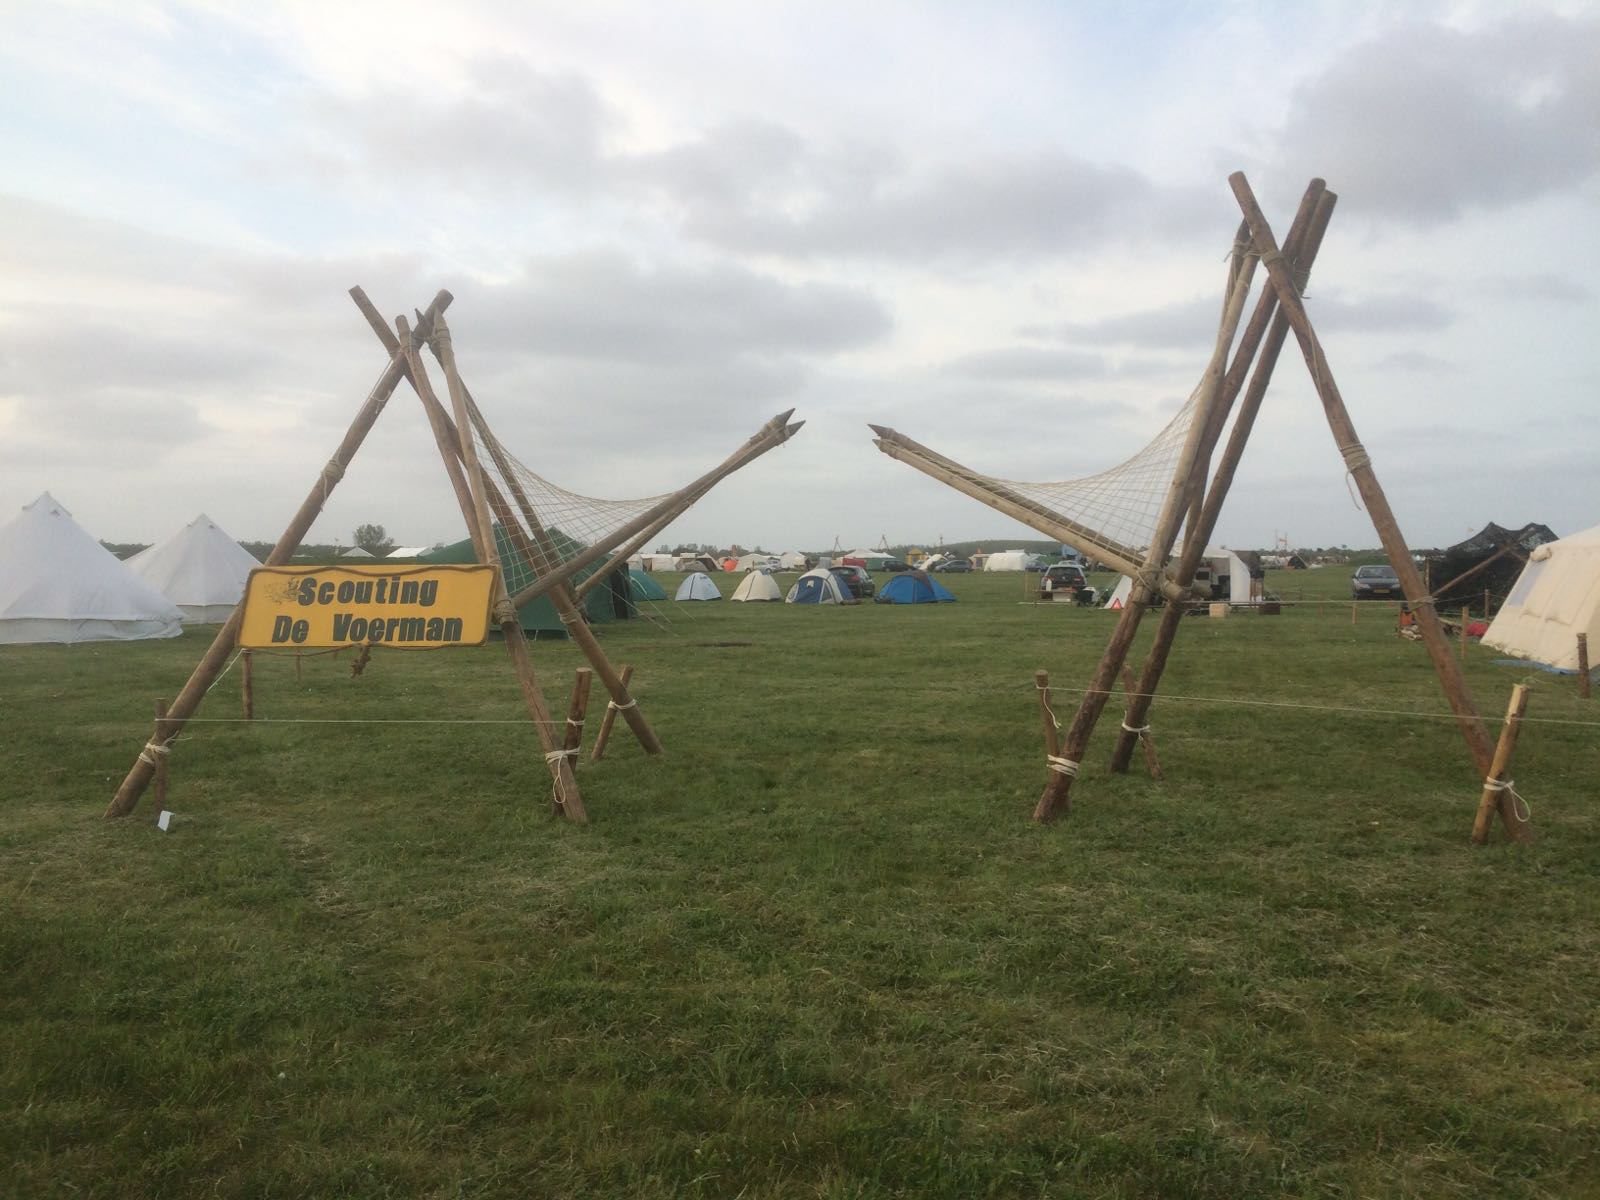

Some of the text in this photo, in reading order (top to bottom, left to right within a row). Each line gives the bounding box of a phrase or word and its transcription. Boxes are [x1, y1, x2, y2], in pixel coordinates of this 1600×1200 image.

[297, 576, 438, 607] Scouting
[271, 613, 463, 643] De Voerman
